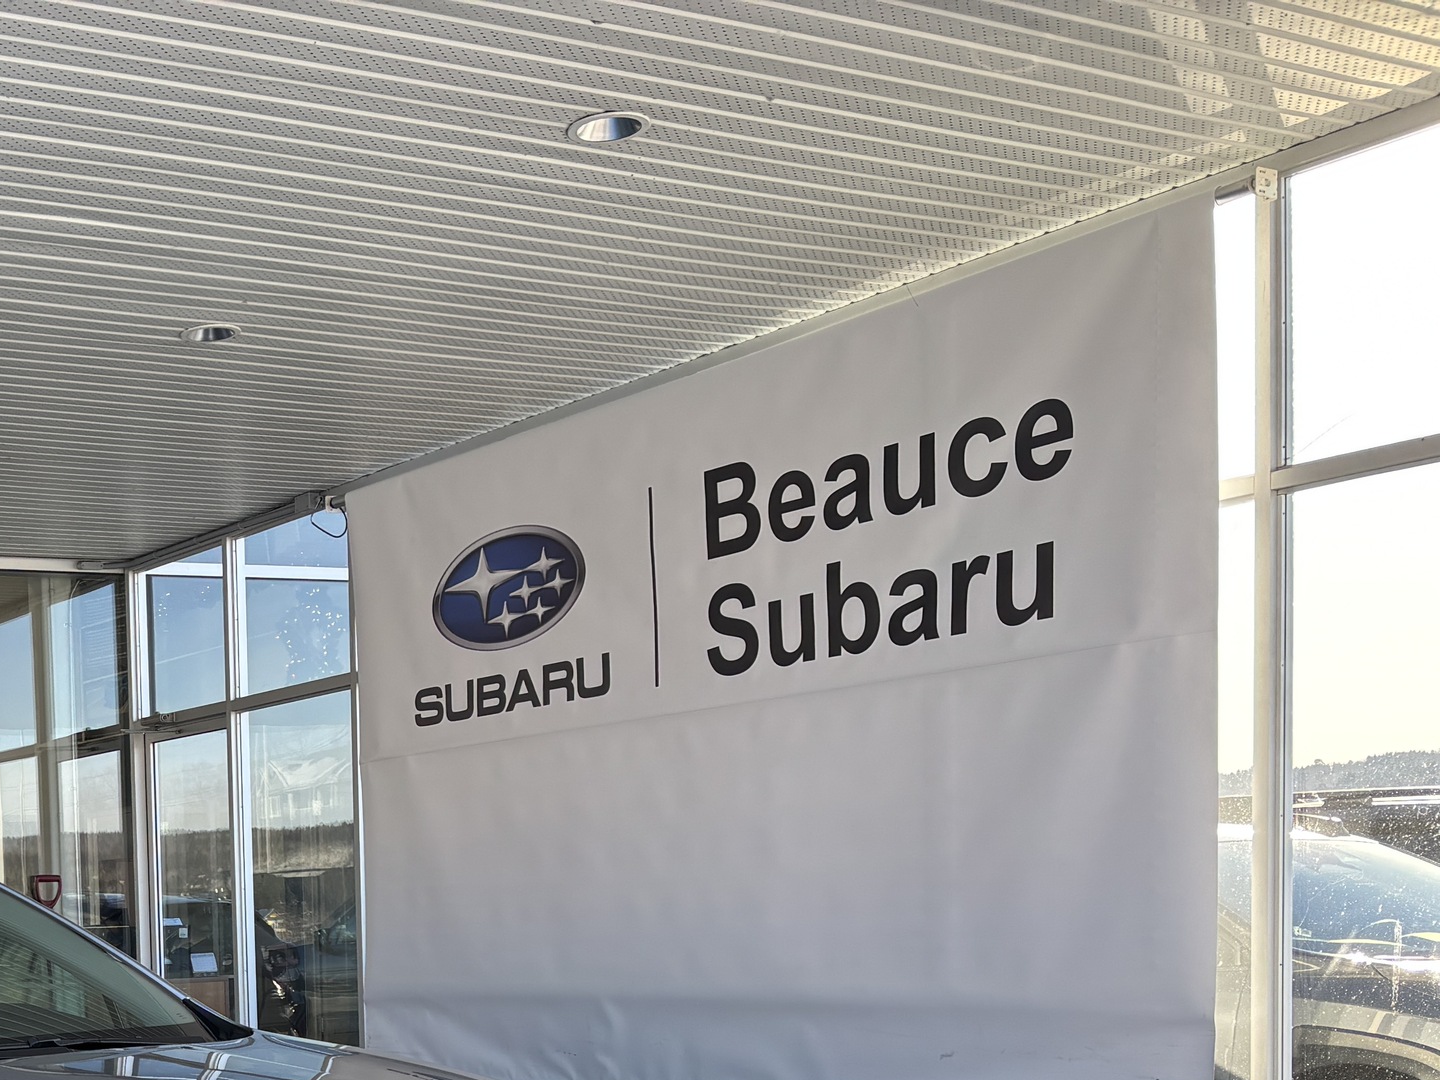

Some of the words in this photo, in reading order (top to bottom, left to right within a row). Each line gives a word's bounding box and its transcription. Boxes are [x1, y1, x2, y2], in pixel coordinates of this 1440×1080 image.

[704, 398, 1074, 560] Beauce
[706, 541, 1055, 677] Subaru
[414, 653, 611, 727] SUBARU
